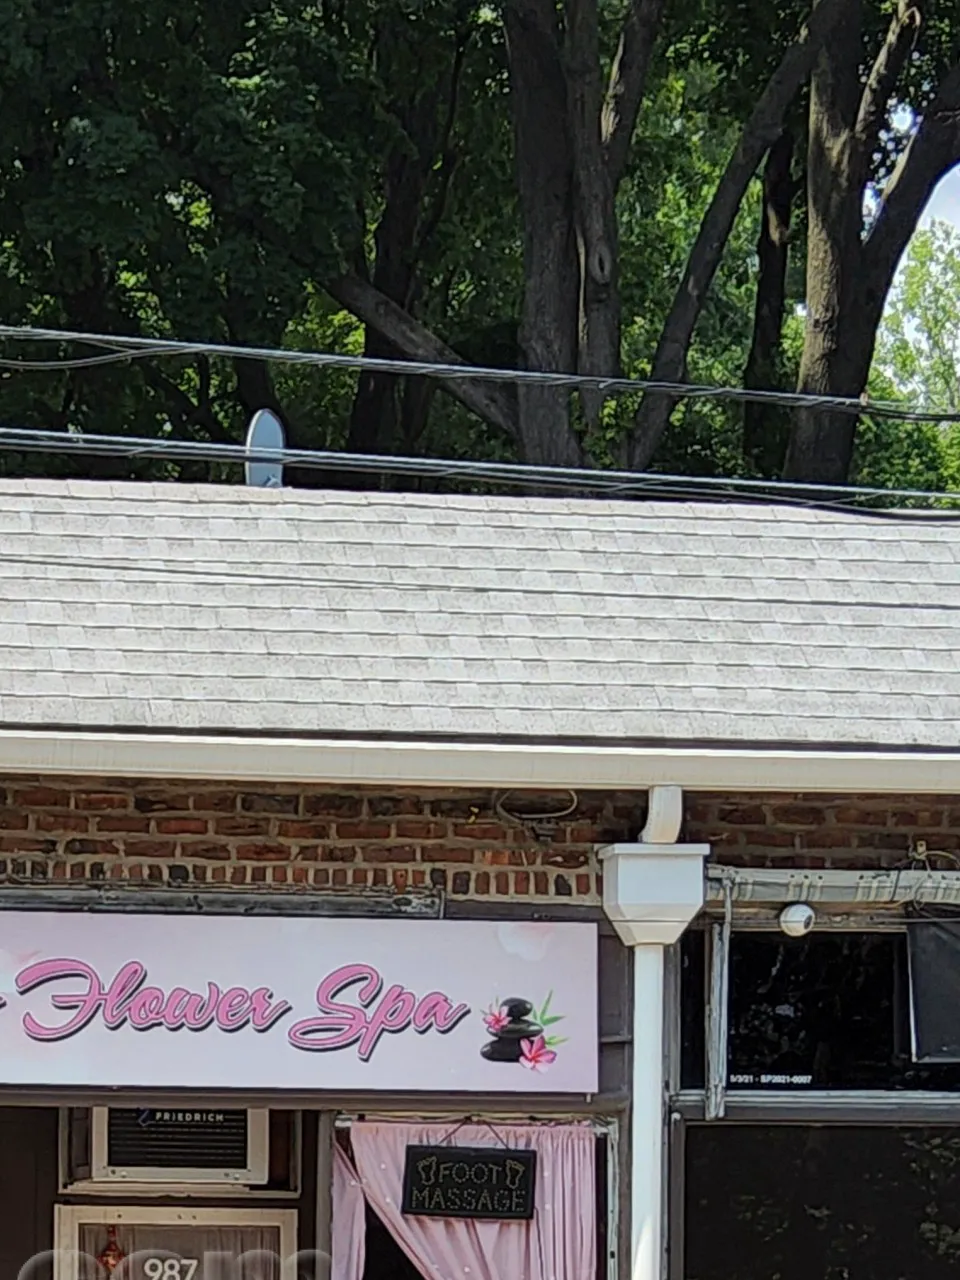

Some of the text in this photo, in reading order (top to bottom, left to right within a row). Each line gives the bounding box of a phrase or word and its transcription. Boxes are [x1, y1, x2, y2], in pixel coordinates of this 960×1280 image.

[15, 958, 290, 1042] Flower
[287, 963, 469, 1062] Spa
[155, 1111, 224, 1122] FRIEDRICH
[440, 1161, 503, 1185] FOOT
[411, 1186, 527, 1213] MASSAGE
